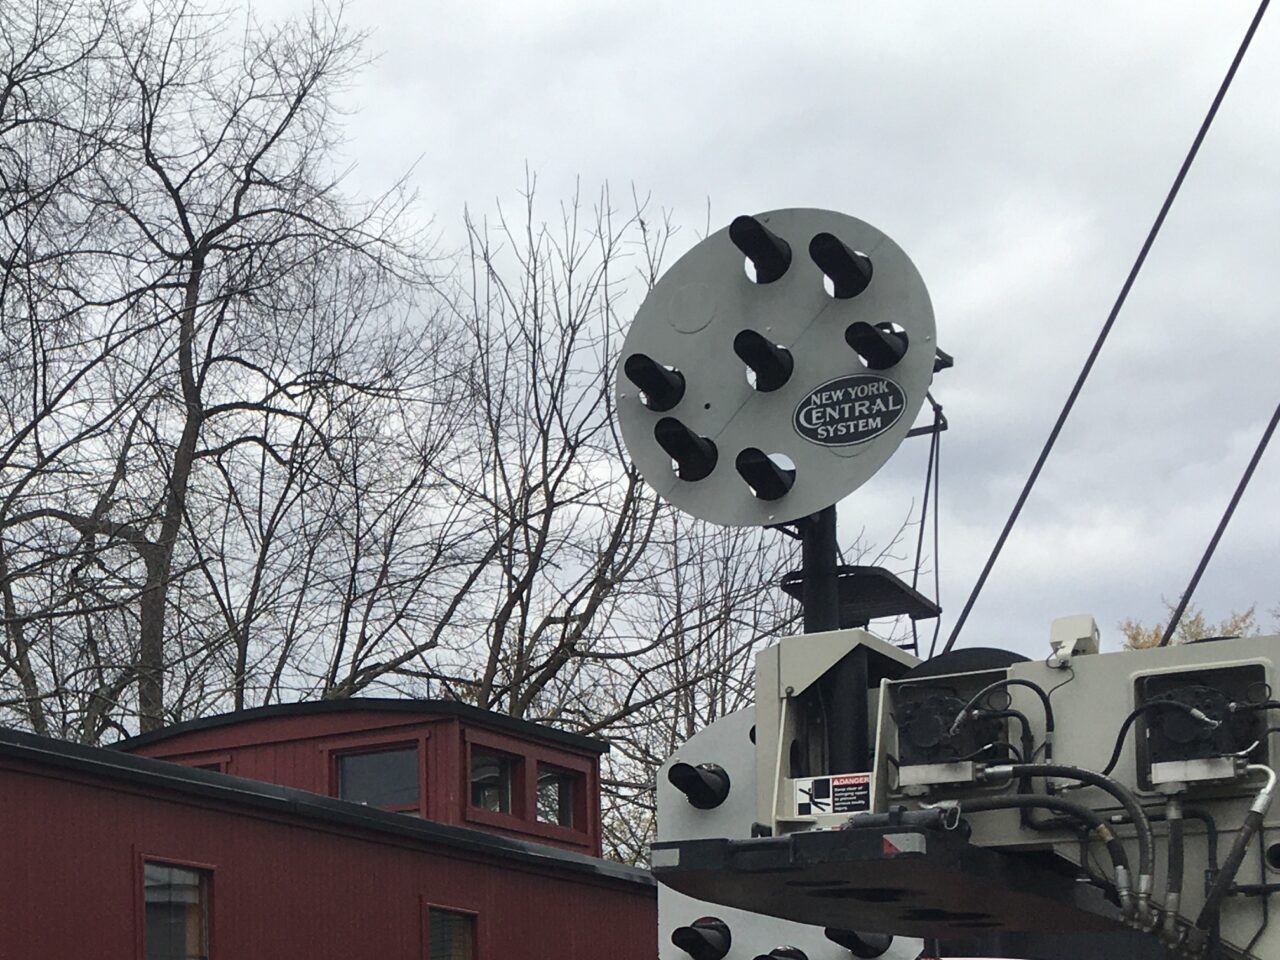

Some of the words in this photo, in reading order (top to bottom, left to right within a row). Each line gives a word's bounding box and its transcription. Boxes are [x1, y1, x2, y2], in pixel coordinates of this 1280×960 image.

[810, 388, 846, 406] NEW
[847, 380, 890, 399] YORK
[799, 395, 902, 429] CENTRAL
[817, 417, 881, 439] SYSTEM
[839, 777, 870, 785] DANGER
